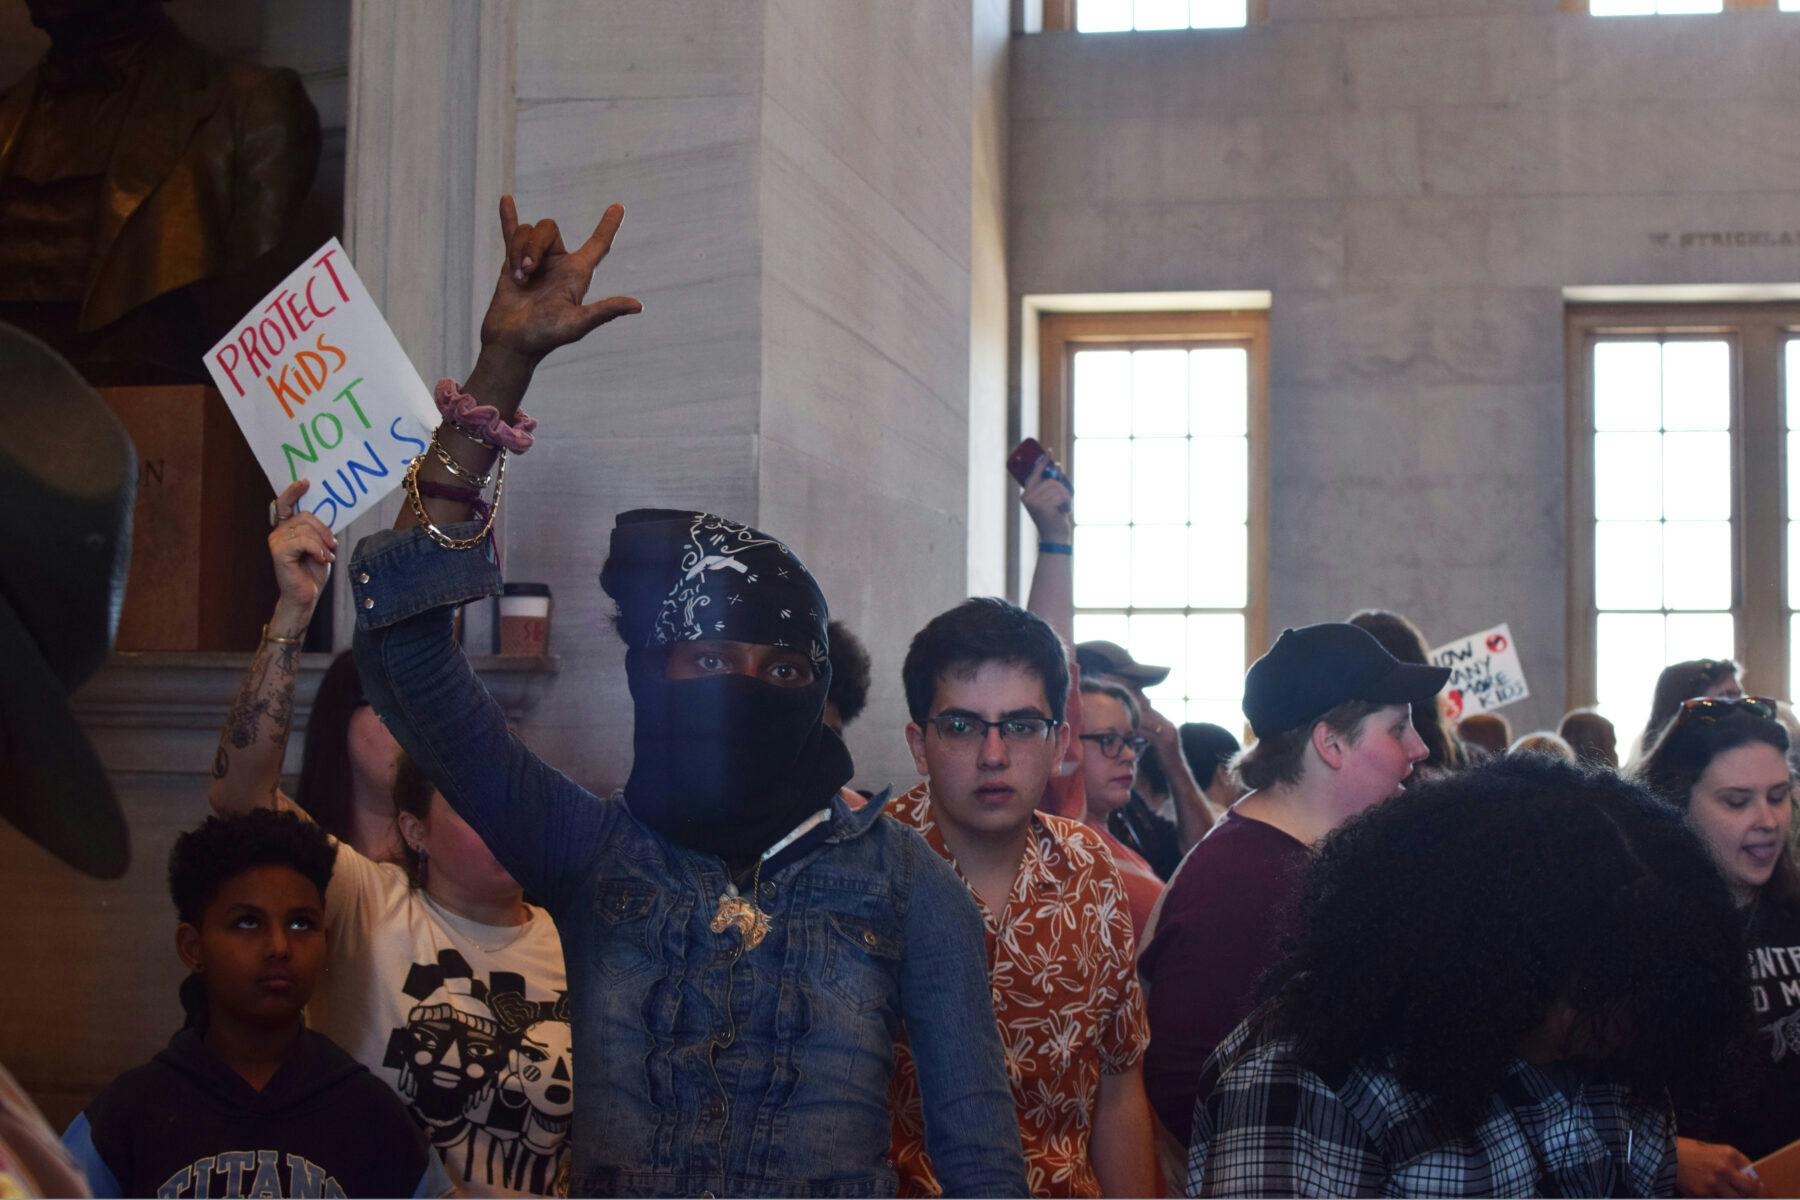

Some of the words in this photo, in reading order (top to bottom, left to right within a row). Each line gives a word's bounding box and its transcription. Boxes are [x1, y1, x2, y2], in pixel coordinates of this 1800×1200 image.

[1680, 231, 1800, 248] STRICKLA
[215, 249, 350, 398] PROTECT
[281, 377, 372, 482] NOT
[1434, 642, 1473, 667] OW
